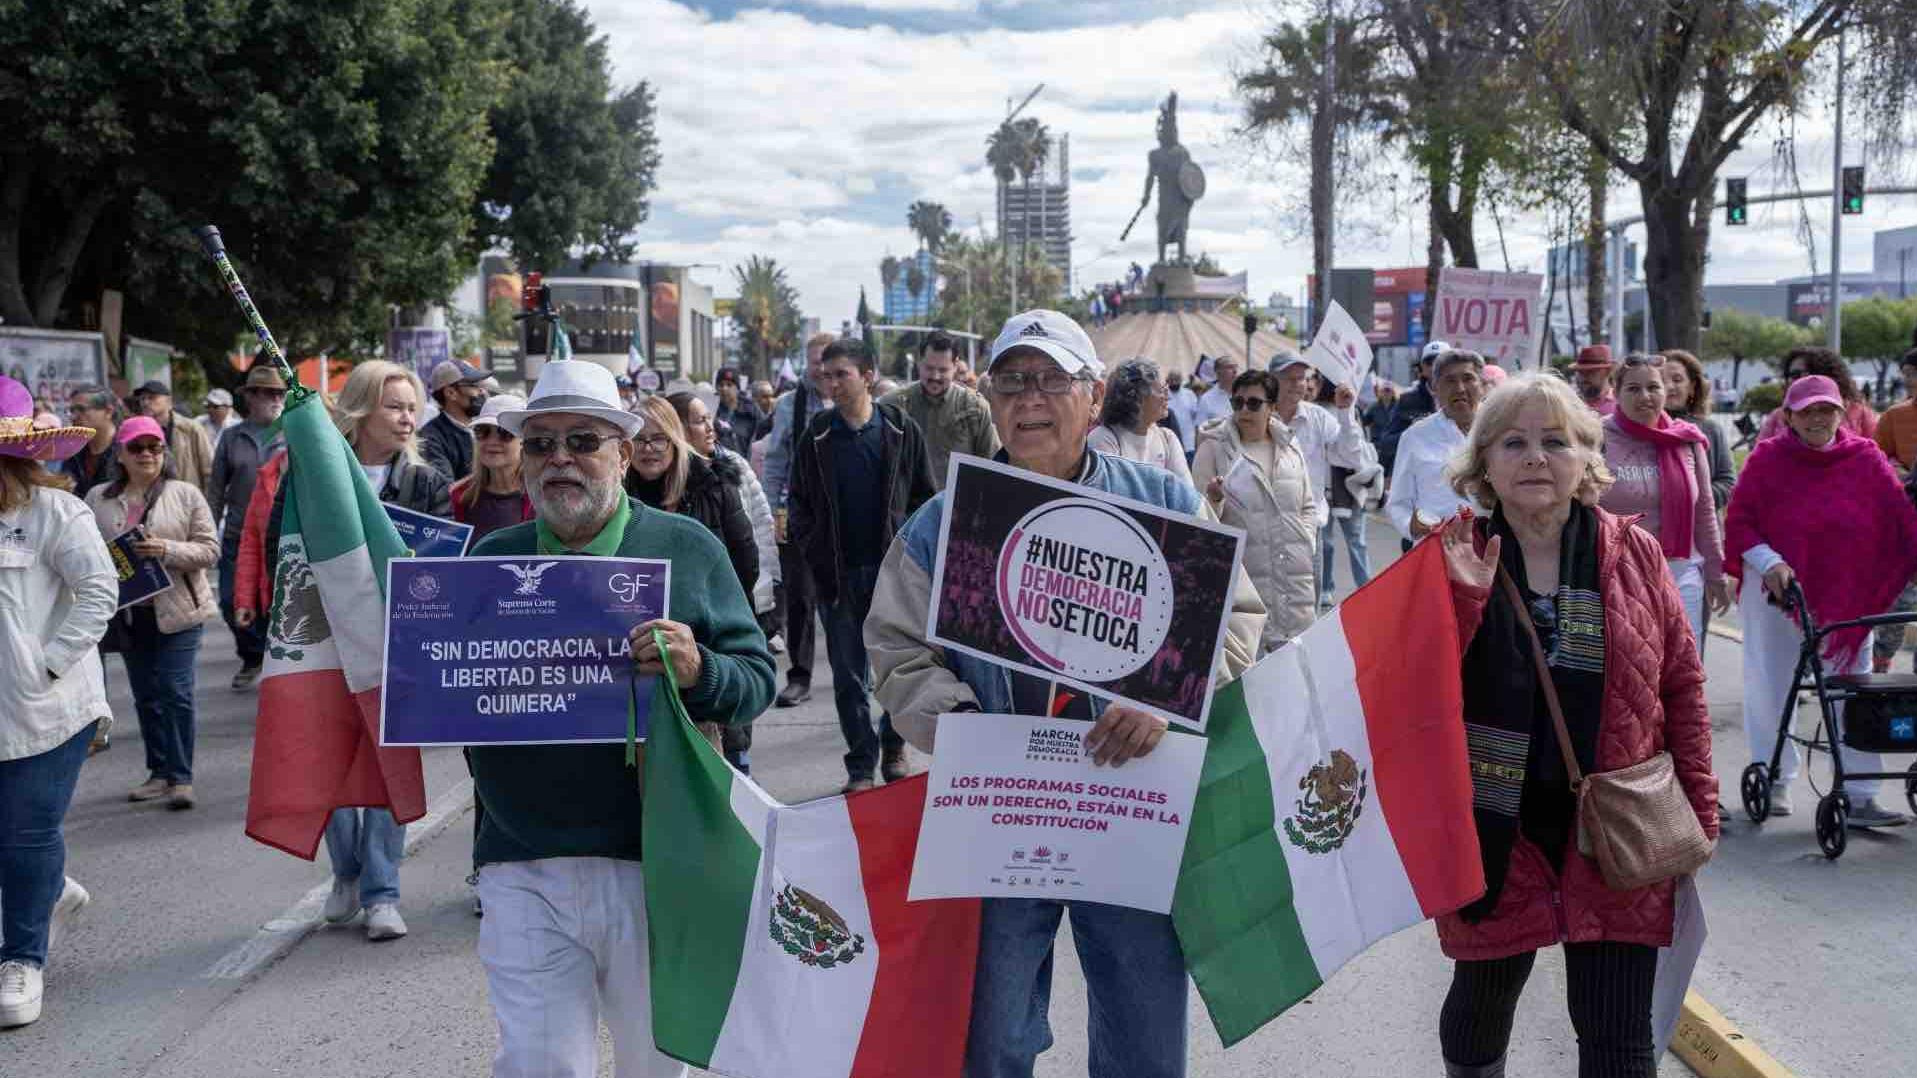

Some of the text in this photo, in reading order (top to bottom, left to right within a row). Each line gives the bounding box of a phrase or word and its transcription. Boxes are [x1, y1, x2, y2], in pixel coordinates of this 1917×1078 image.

[1443, 298, 1530, 335] VOTA
[1026, 534, 1149, 597] #NUESTRA
[498, 599, 556, 609] Suprema Corte
[1020, 563, 1144, 622] DEMOCRACIA
[467, 638, 602, 660] DEMOCRACIA,
[608, 637, 632, 657] LA
[441, 664, 614, 688] LIBERTAD ES UNA
[1029, 738, 1080, 749] POR NUESTRA
[1031, 729, 1081, 742] MARCHA
[1027, 745, 1079, 756] DEMOCRACIA
[950, 776, 1168, 805] LOS PROGRAMAS SOCIALES
[932, 795, 1180, 825] SON UN DERECHO, ESTÁN EN LA
[991, 812, 1108, 832] CONSTITUCIÓN
